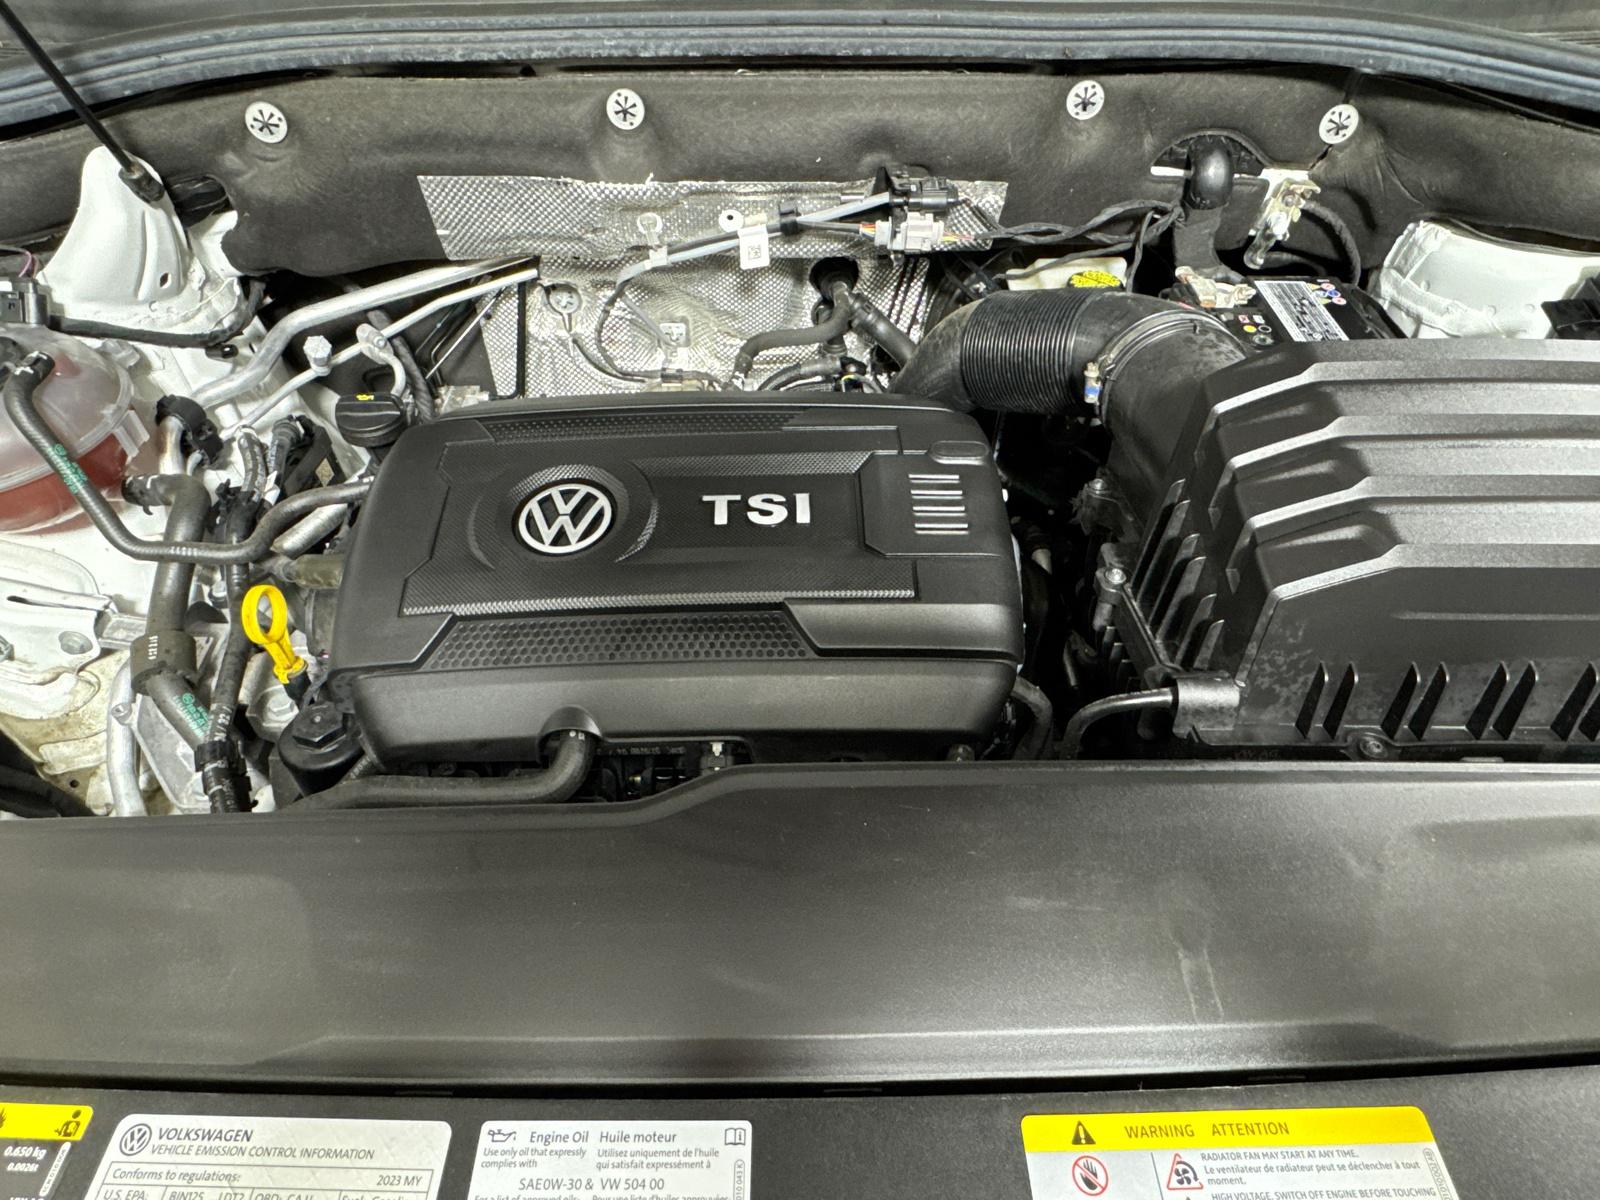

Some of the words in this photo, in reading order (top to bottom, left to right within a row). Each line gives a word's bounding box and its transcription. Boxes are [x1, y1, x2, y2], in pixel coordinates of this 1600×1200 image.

[702, 493, 812, 526] TSI
[157, 1127, 253, 1142] VOLKSWAGEN
[1124, 1124, 1195, 1139] WARNING
[1211, 1121, 1290, 1136] ATTENTION
[529, 1130, 569, 1146] Engine
[572, 1131, 589, 1143] Oil
[599, 1131, 630, 1143] Huile
[633, 1131, 676, 1144] moteur
[3, 1145, 33, 1158] 0.650
[32, 1146, 47, 1161] kg
[151, 1144, 193, 1155] VEHICLE
[195, 1145, 246, 1156] EMISSION
[249, 1146, 297, 1158] CONTROL
[299, 1147, 375, 1160] INFORMATION
[483, 1148, 499, 1156] Use
[500, 1147, 518, 1159] only
[518, 1147, 530, 1157] oil
[530, 1147, 548, 1157] that
[549, 1147, 587, 1159] expressly
[597, 1148, 627, 1158] Utilisez
[630, 1149, 681, 1160] uniquement
[682, 1148, 693, 1158] de
[1200, 1151, 1242, 1161] RADIATOR
[1243, 1151, 1260, 1160] FAN
[1261, 1151, 1279, 1160] MAY
[1280, 1150, 1306, 1160] START
[1306, 1150, 1317, 1159] AT
[1318, 1149, 1335, 1158] ANY
[1336, 1149, 1359, 1158] TIME.
[481, 1159, 517, 1171] complies
[518, 1159, 537, 1169] with
[595, 1160, 610, 1171] qui
[611, 1160, 644, 1170] satisfait
[646, 1160, 704, 1171] expressément
[705, 1160, 711, 1169] à
[1204, 1165, 1215, 1175] Le
[1216, 1165, 1261, 1174] ventilateur
[1263, 1163, 1275, 1173] de
[1276, 1163, 1314, 1173] radiateur
[1316, 1162, 1335, 1174] peut
[1337, 1163, 1346, 1172] se
[1348, 1160, 1392, 1171] déclencher
[1394, 1160, 1401, 1170] à
[1401, 1160, 1421, 1170] tout
[112, 1168, 162, 1180] Conforms
[165, 1170, 176, 1181] to
[178, 1170, 241, 1184] regulations:
[376, 1174, 402, 1186] 2023
[403, 1175, 422, 1187] MY
[1207, 1176, 1247, 1185] moment.
[518, 1178, 582, 1191] SAE0W-30
[584, 1178, 594, 1191] &
[600, 1178, 622, 1191] VW
[623, 1178, 647, 1191] 504
[650, 1178, 665, 1191] 00
[1274, 1191, 1307, 1200] SWITCH
[1308, 1190, 1324, 1200] OFF
[1325, 1189, 1358, 1199] ENGINE
[1360, 1188, 1391, 1199] BEFORE
[1394, 1187, 1437, 1198] TOUCHING
